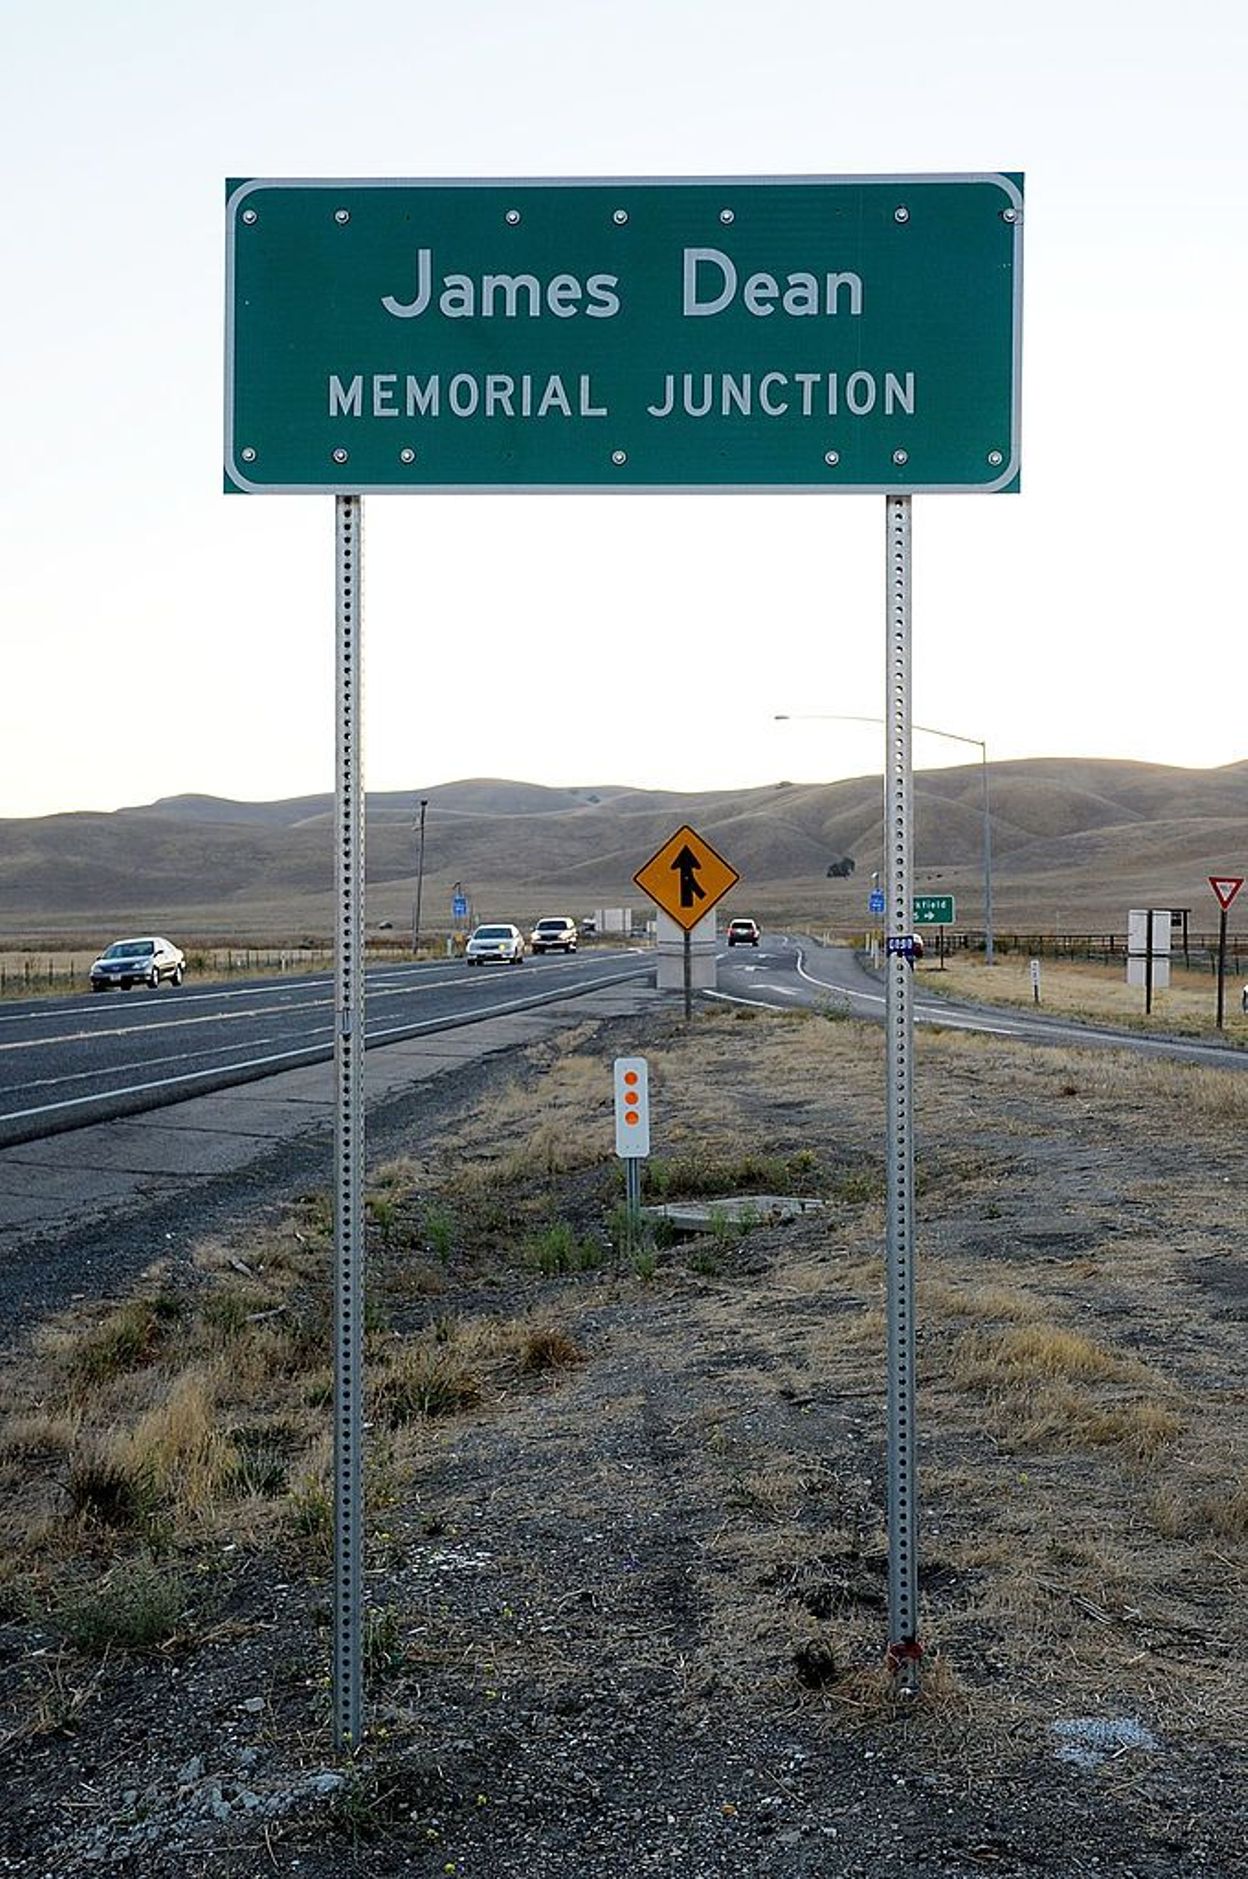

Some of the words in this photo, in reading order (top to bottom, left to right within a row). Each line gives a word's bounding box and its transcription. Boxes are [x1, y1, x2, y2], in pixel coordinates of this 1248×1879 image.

[381, 249, 620, 319] James
[683, 248, 862, 317] Dean
[328, 374, 609, 418] MEMORIAL
[647, 371, 917, 417] JUNCTION
